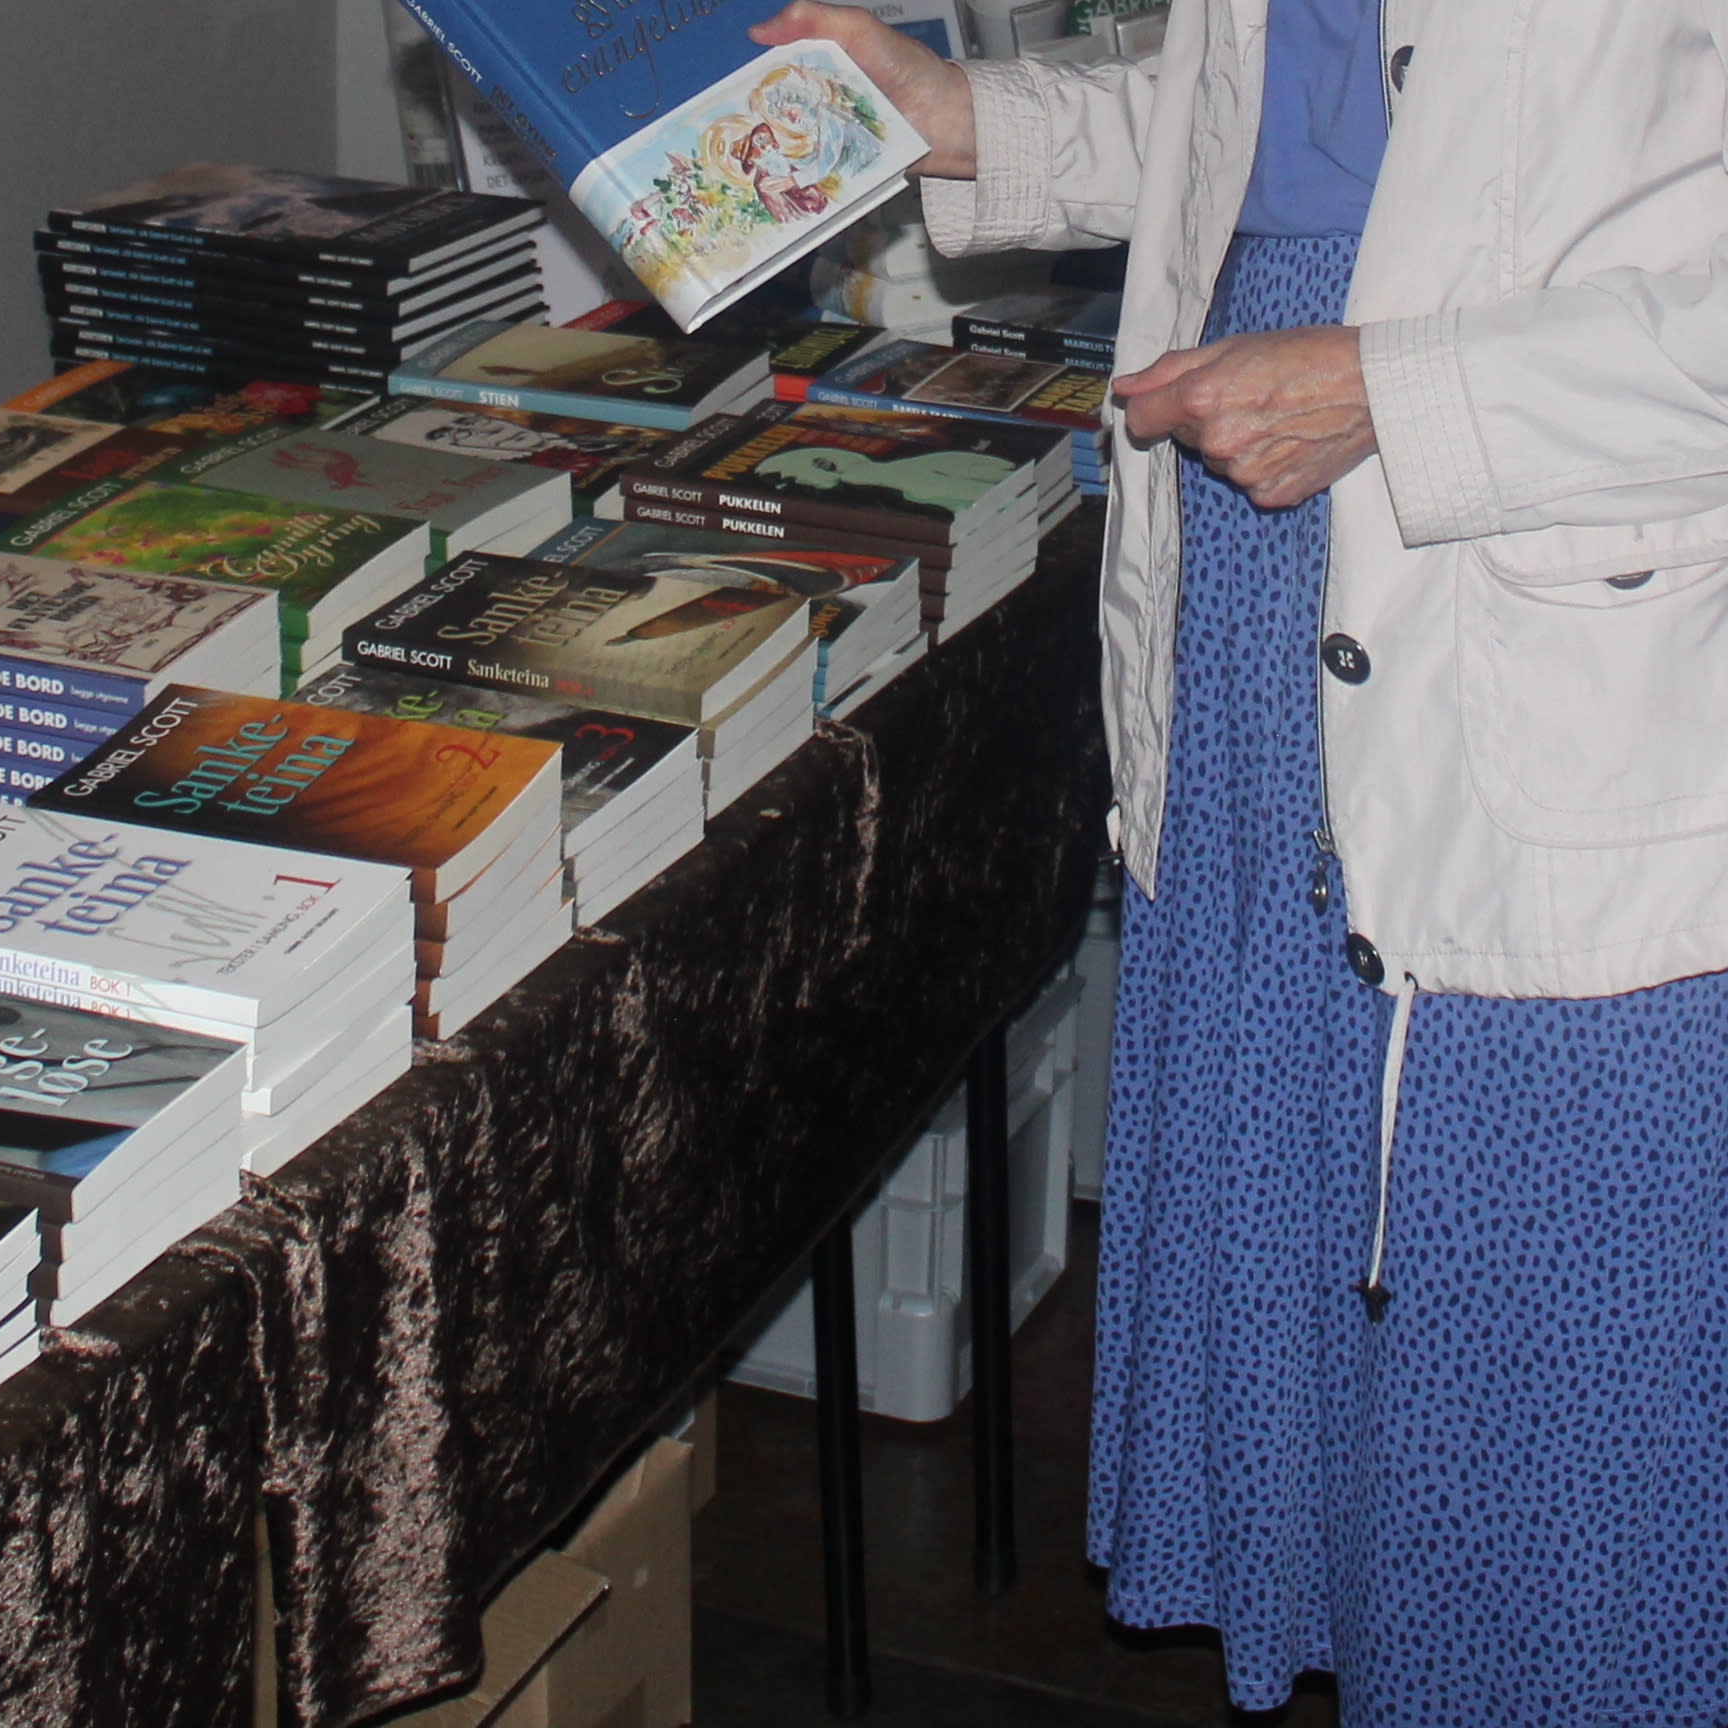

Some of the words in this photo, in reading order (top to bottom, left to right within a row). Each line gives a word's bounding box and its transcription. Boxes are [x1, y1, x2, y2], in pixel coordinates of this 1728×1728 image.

[447, 41, 483, 83] SCOTT
[479, 391, 519, 408] STIEN
[718, 493, 782, 515] PUKKELEN
[722, 517, 785, 539] PUKKELEN
[438, 559, 488, 596] SCOTT
[436, 571, 565, 647] Sanke-
[518, 582, 629, 648] teina
[357, 639, 409, 664] GABRIEL
[411, 647, 453, 670] SCOTT
[467, 658, 550, 689] Sanketeina
[15, 674, 64, 696] BORD
[19, 709, 67, 730] BORD
[17, 741, 65, 763] BORD
[63, 747, 144, 798] GABRIEL
[139, 696, 200, 748] SCOTT
[133, 713, 289, 815] Sanke-
[436, 741, 501, 772] 2
[217, 734, 356, 816] teina
[37, 852, 192, 937] teina
[89, 975, 121, 994] BOK
